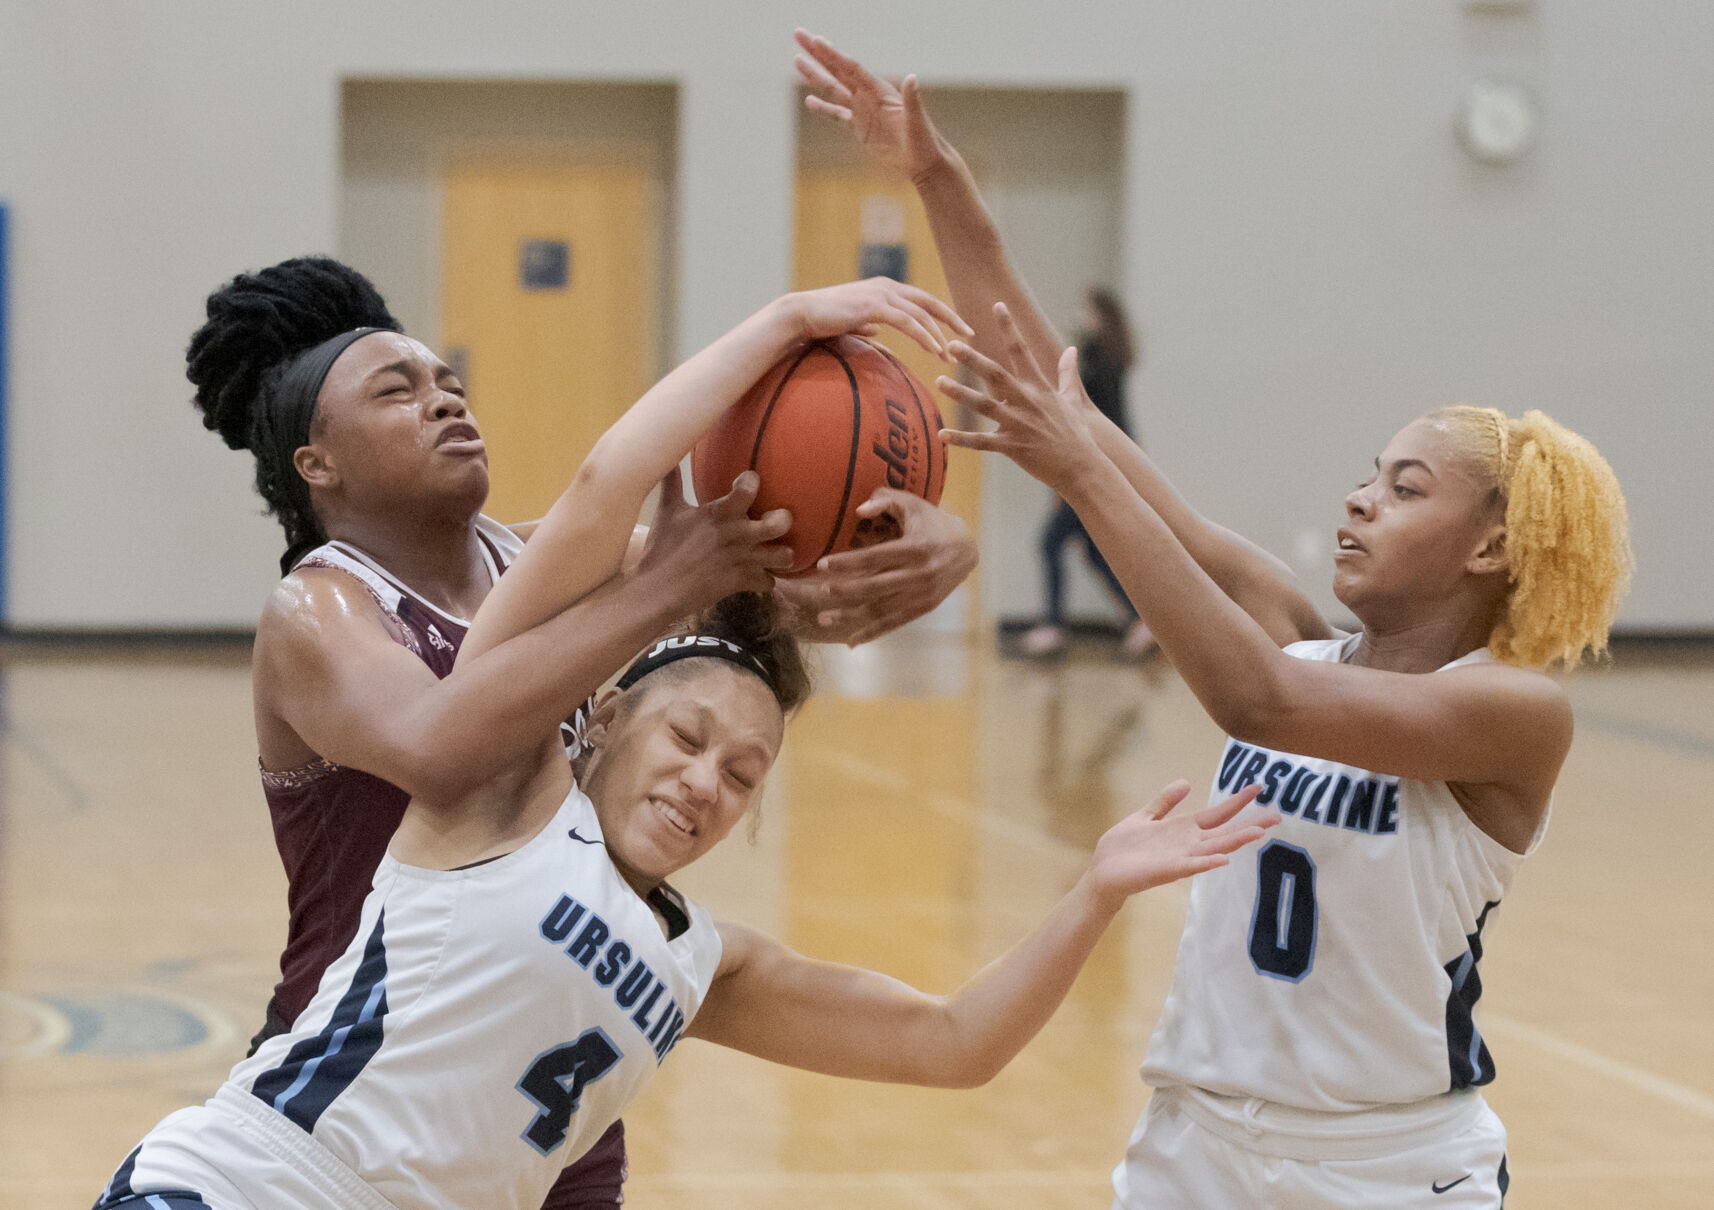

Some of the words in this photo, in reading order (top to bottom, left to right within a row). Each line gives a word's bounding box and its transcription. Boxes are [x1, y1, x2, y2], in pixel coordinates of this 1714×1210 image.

[648, 635, 743, 659] JUST
[1217, 741, 1400, 835] URSULINE
[1247, 838, 1318, 984] 0
[538, 892, 684, 1068] URSULIN
[514, 1025, 624, 1157] 4
